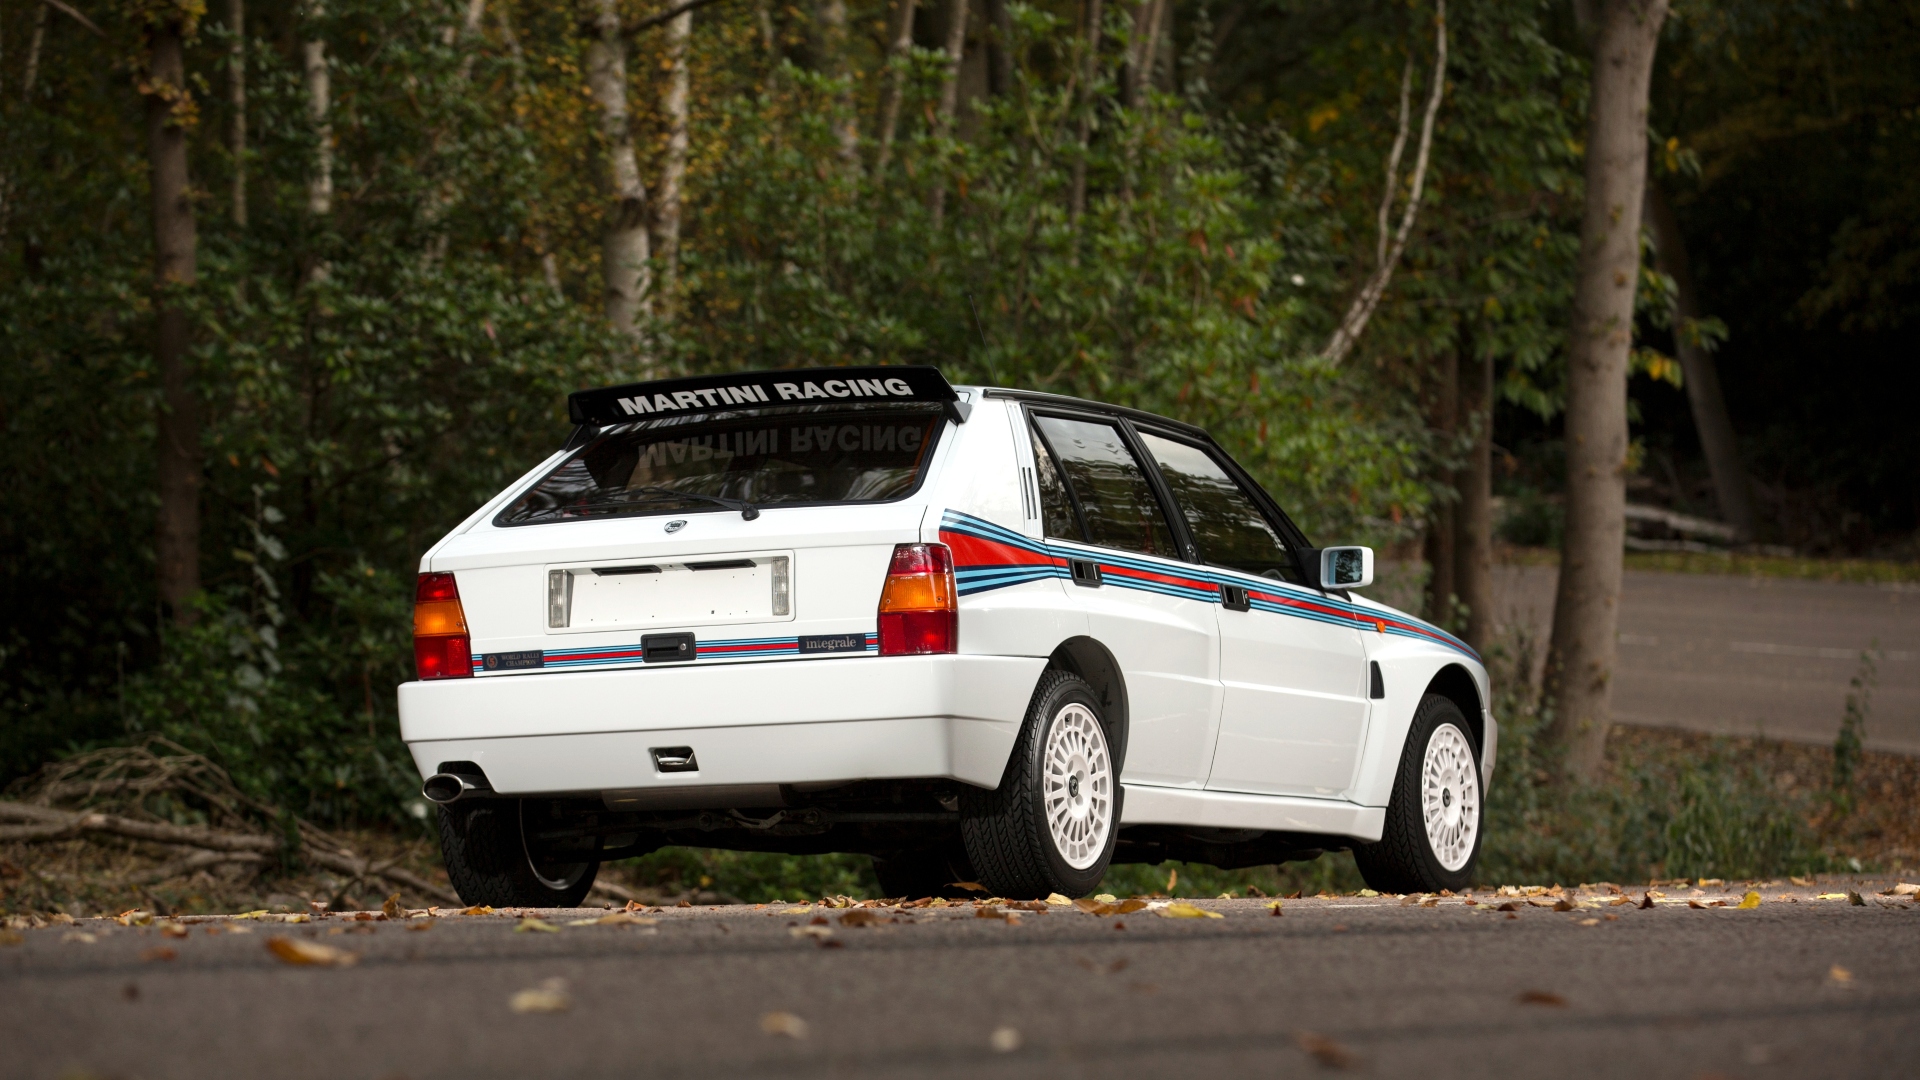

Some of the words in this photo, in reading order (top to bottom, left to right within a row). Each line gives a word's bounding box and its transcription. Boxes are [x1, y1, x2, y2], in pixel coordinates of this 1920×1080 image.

[617, 384, 770, 415] MARTINI
[773, 378, 915, 400] RACING
[805, 636, 857, 650] integrale
